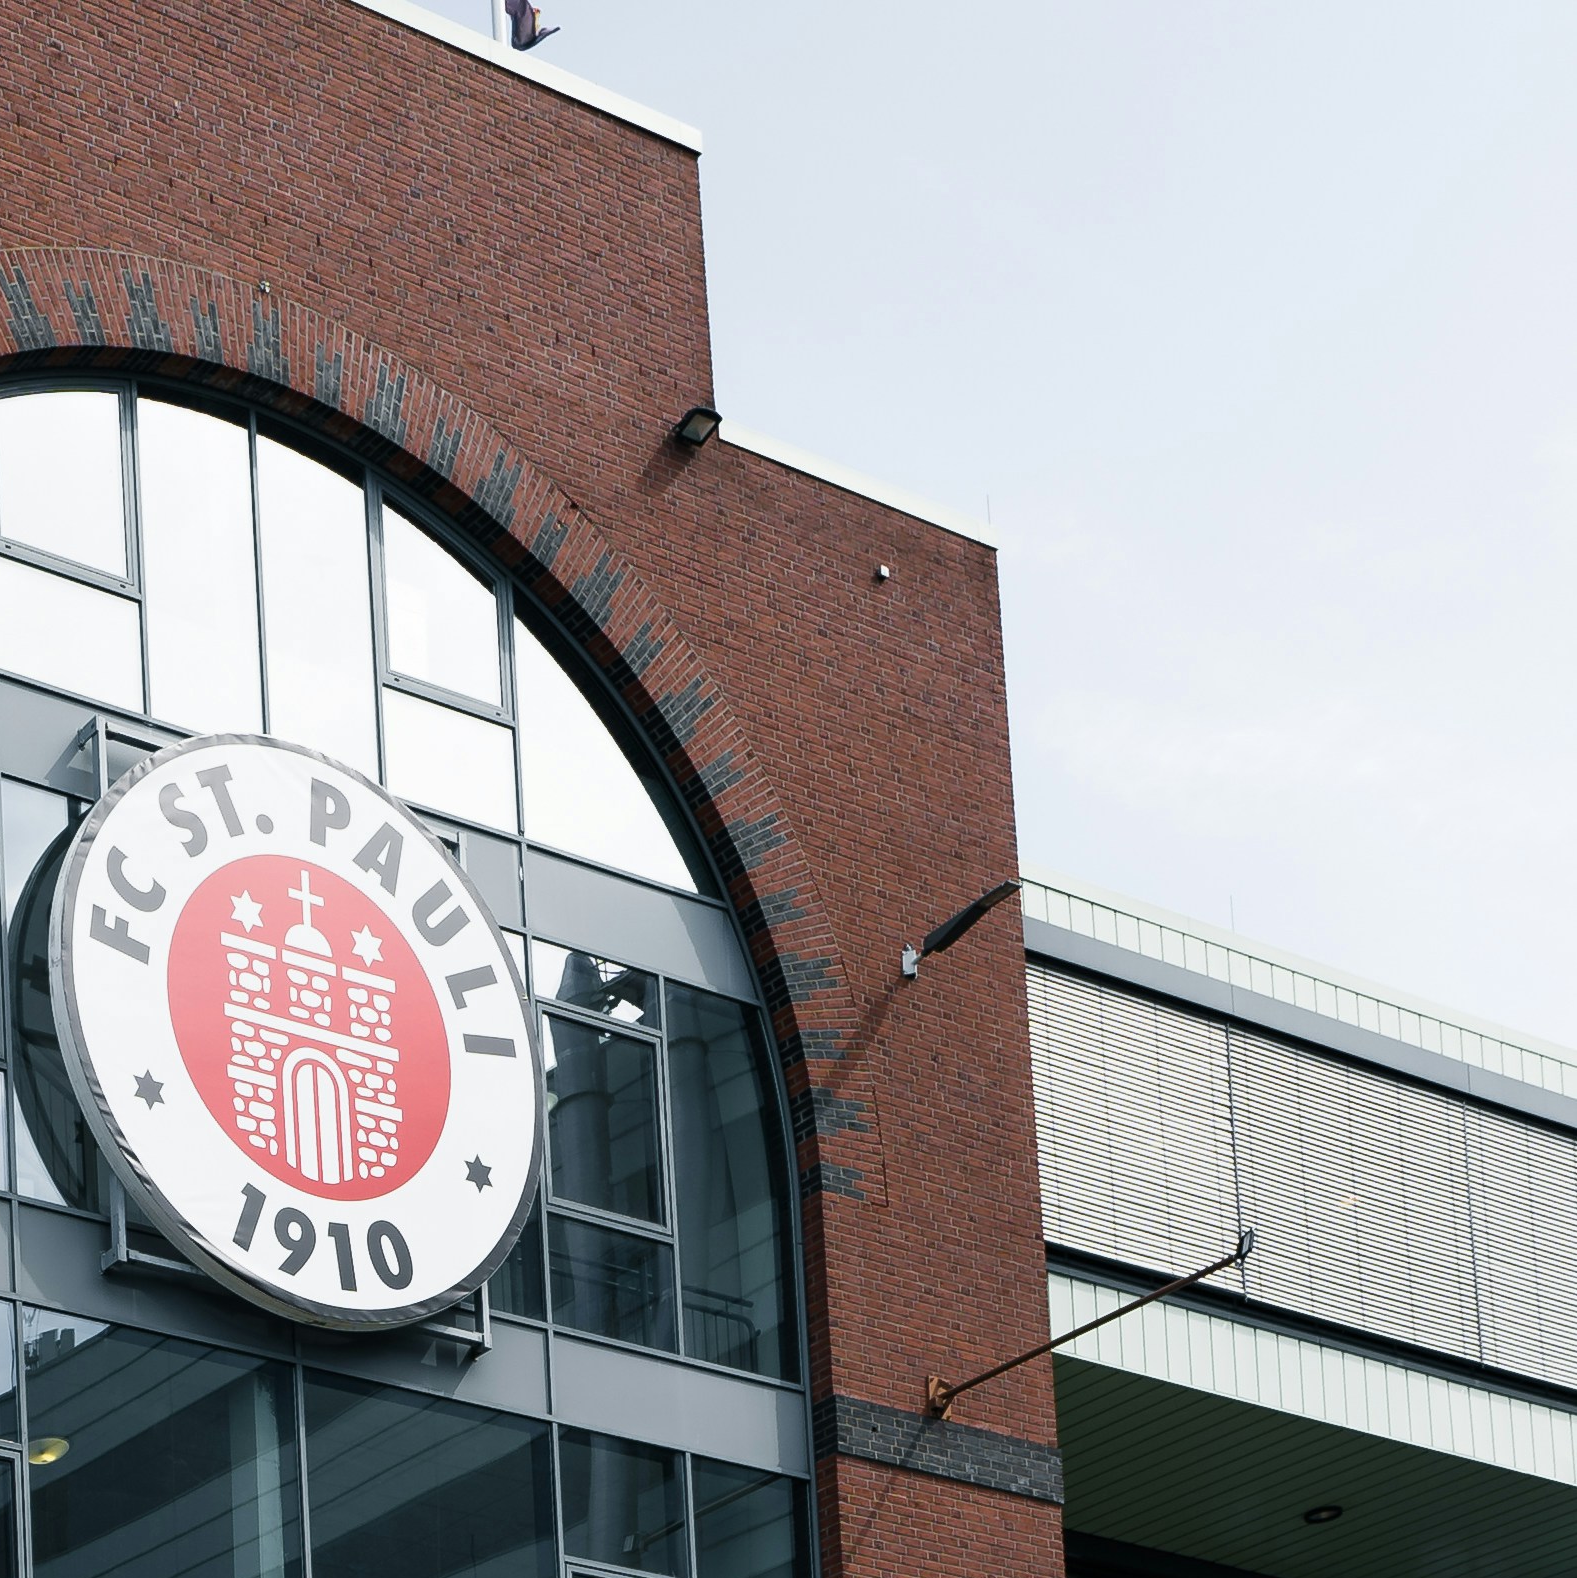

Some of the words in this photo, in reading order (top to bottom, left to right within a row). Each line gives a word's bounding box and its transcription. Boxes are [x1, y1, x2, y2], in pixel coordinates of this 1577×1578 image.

[89, 845, 167, 966] FC
[157, 764, 275, 858] ST.
[309, 776, 518, 1059] PAULI
[231, 1182, 414, 1293] 1910
